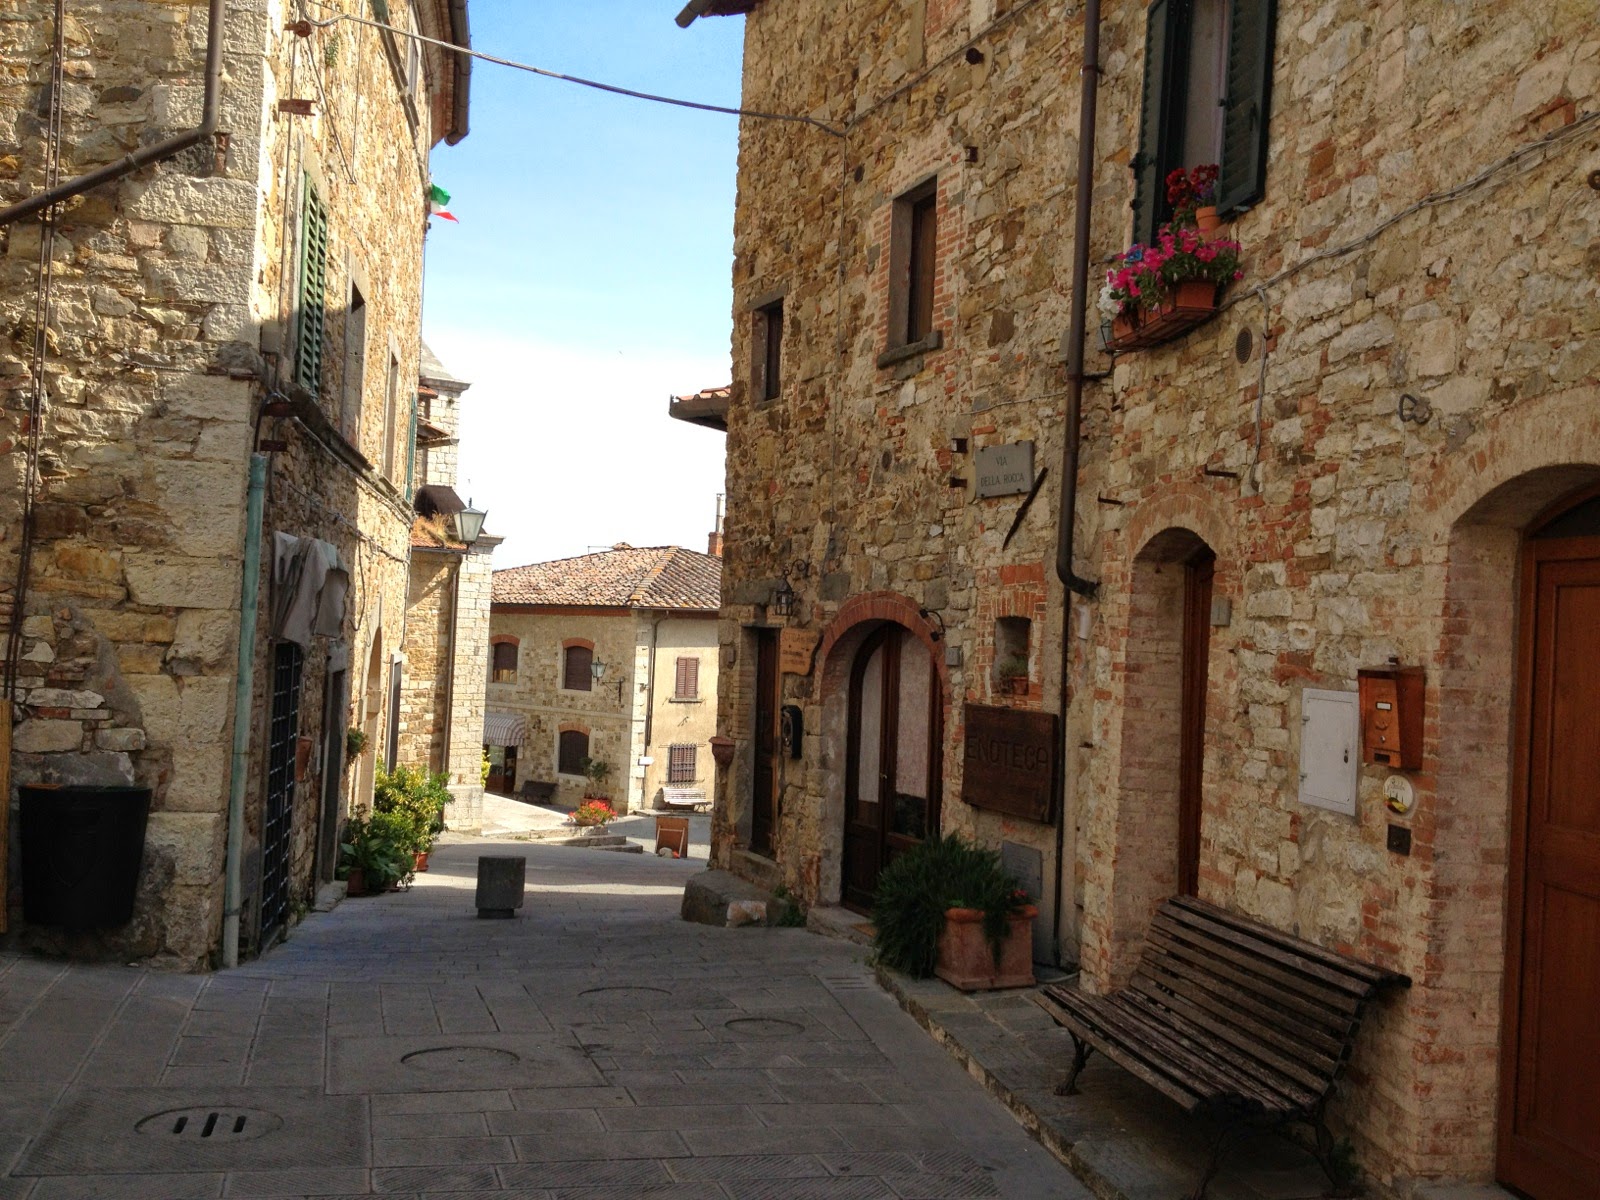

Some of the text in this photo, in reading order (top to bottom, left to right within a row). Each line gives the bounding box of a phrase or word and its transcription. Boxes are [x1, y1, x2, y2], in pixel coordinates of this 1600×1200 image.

[996, 456, 1007, 466] VIA
[980, 472, 1024, 487] DELLA ROCCA
[966, 736, 1049, 772] ENOTECA
